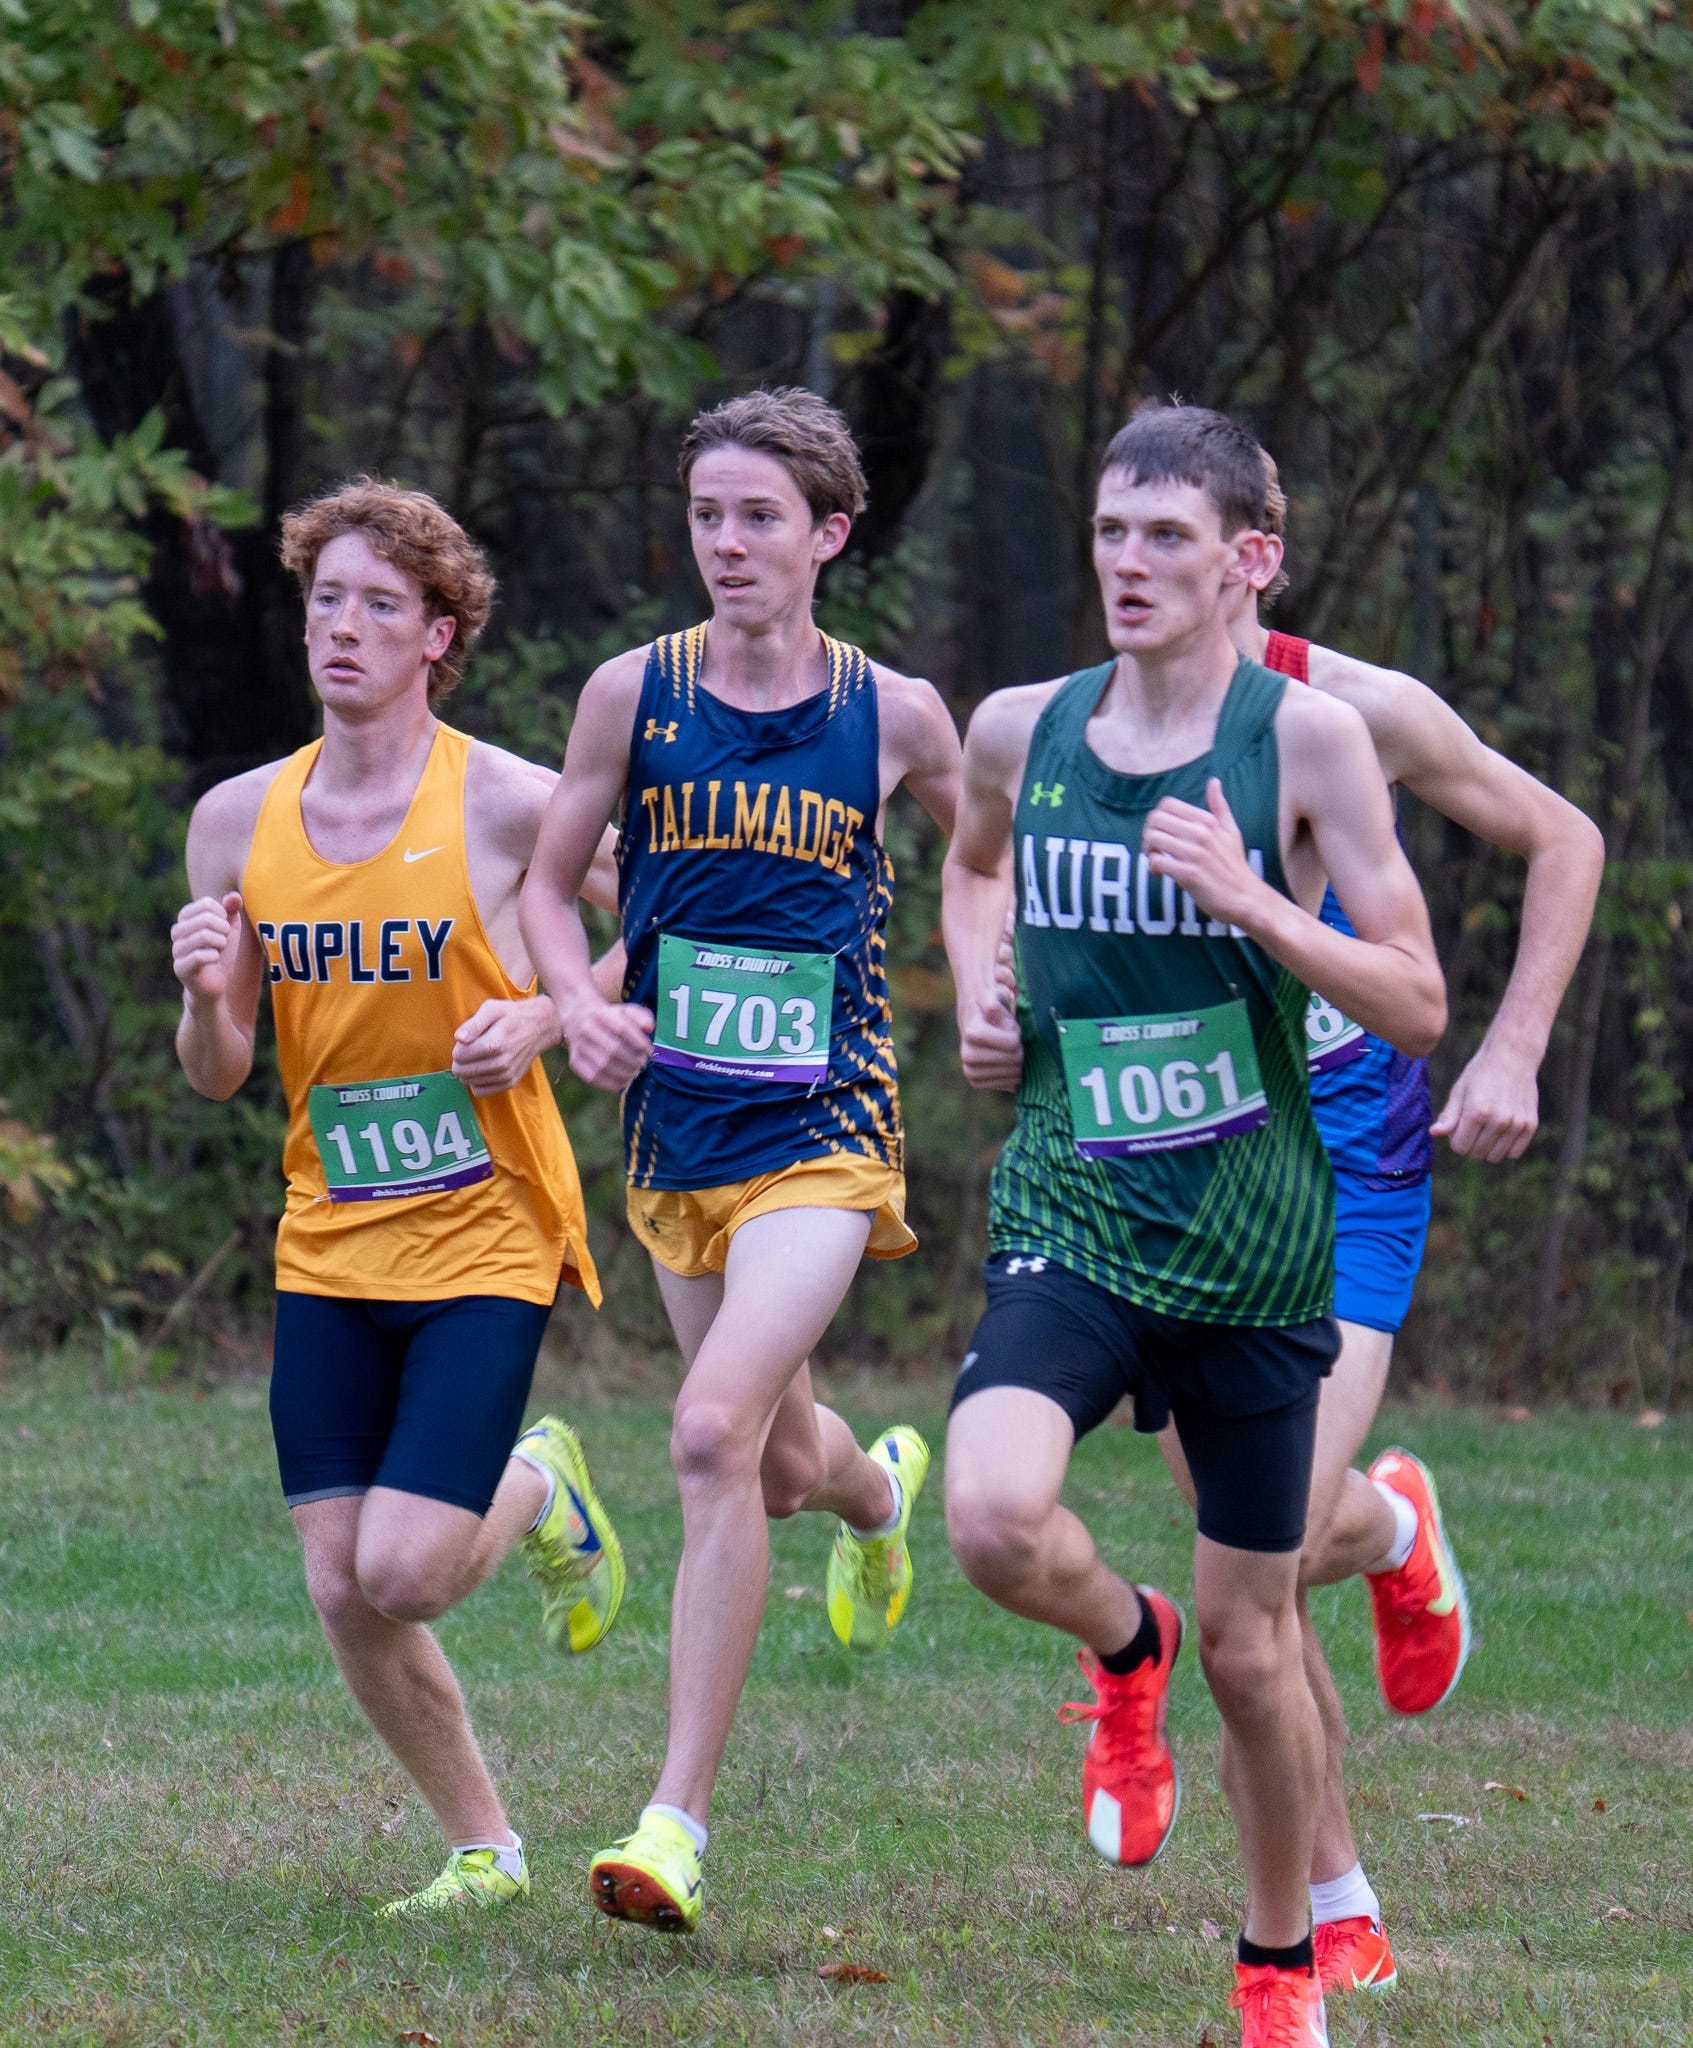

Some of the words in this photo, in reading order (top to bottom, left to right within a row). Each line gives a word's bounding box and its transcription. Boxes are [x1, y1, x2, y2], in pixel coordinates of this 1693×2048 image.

[641, 780, 865, 879] TALLMADGE
[1023, 834, 1265, 939] AURO
[257, 918, 456, 983] COPLEY
[695, 951, 734, 969] CROSS
[734, 956, 791, 974] COUNTRY
[668, 983, 816, 1055] 1703
[339, 1087, 371, 1104] CROSS
[373, 1083, 420, 1101] COUNTRY
[1079, 1050, 1241, 1127] 1061
[325, 1111, 472, 1175] 1194
